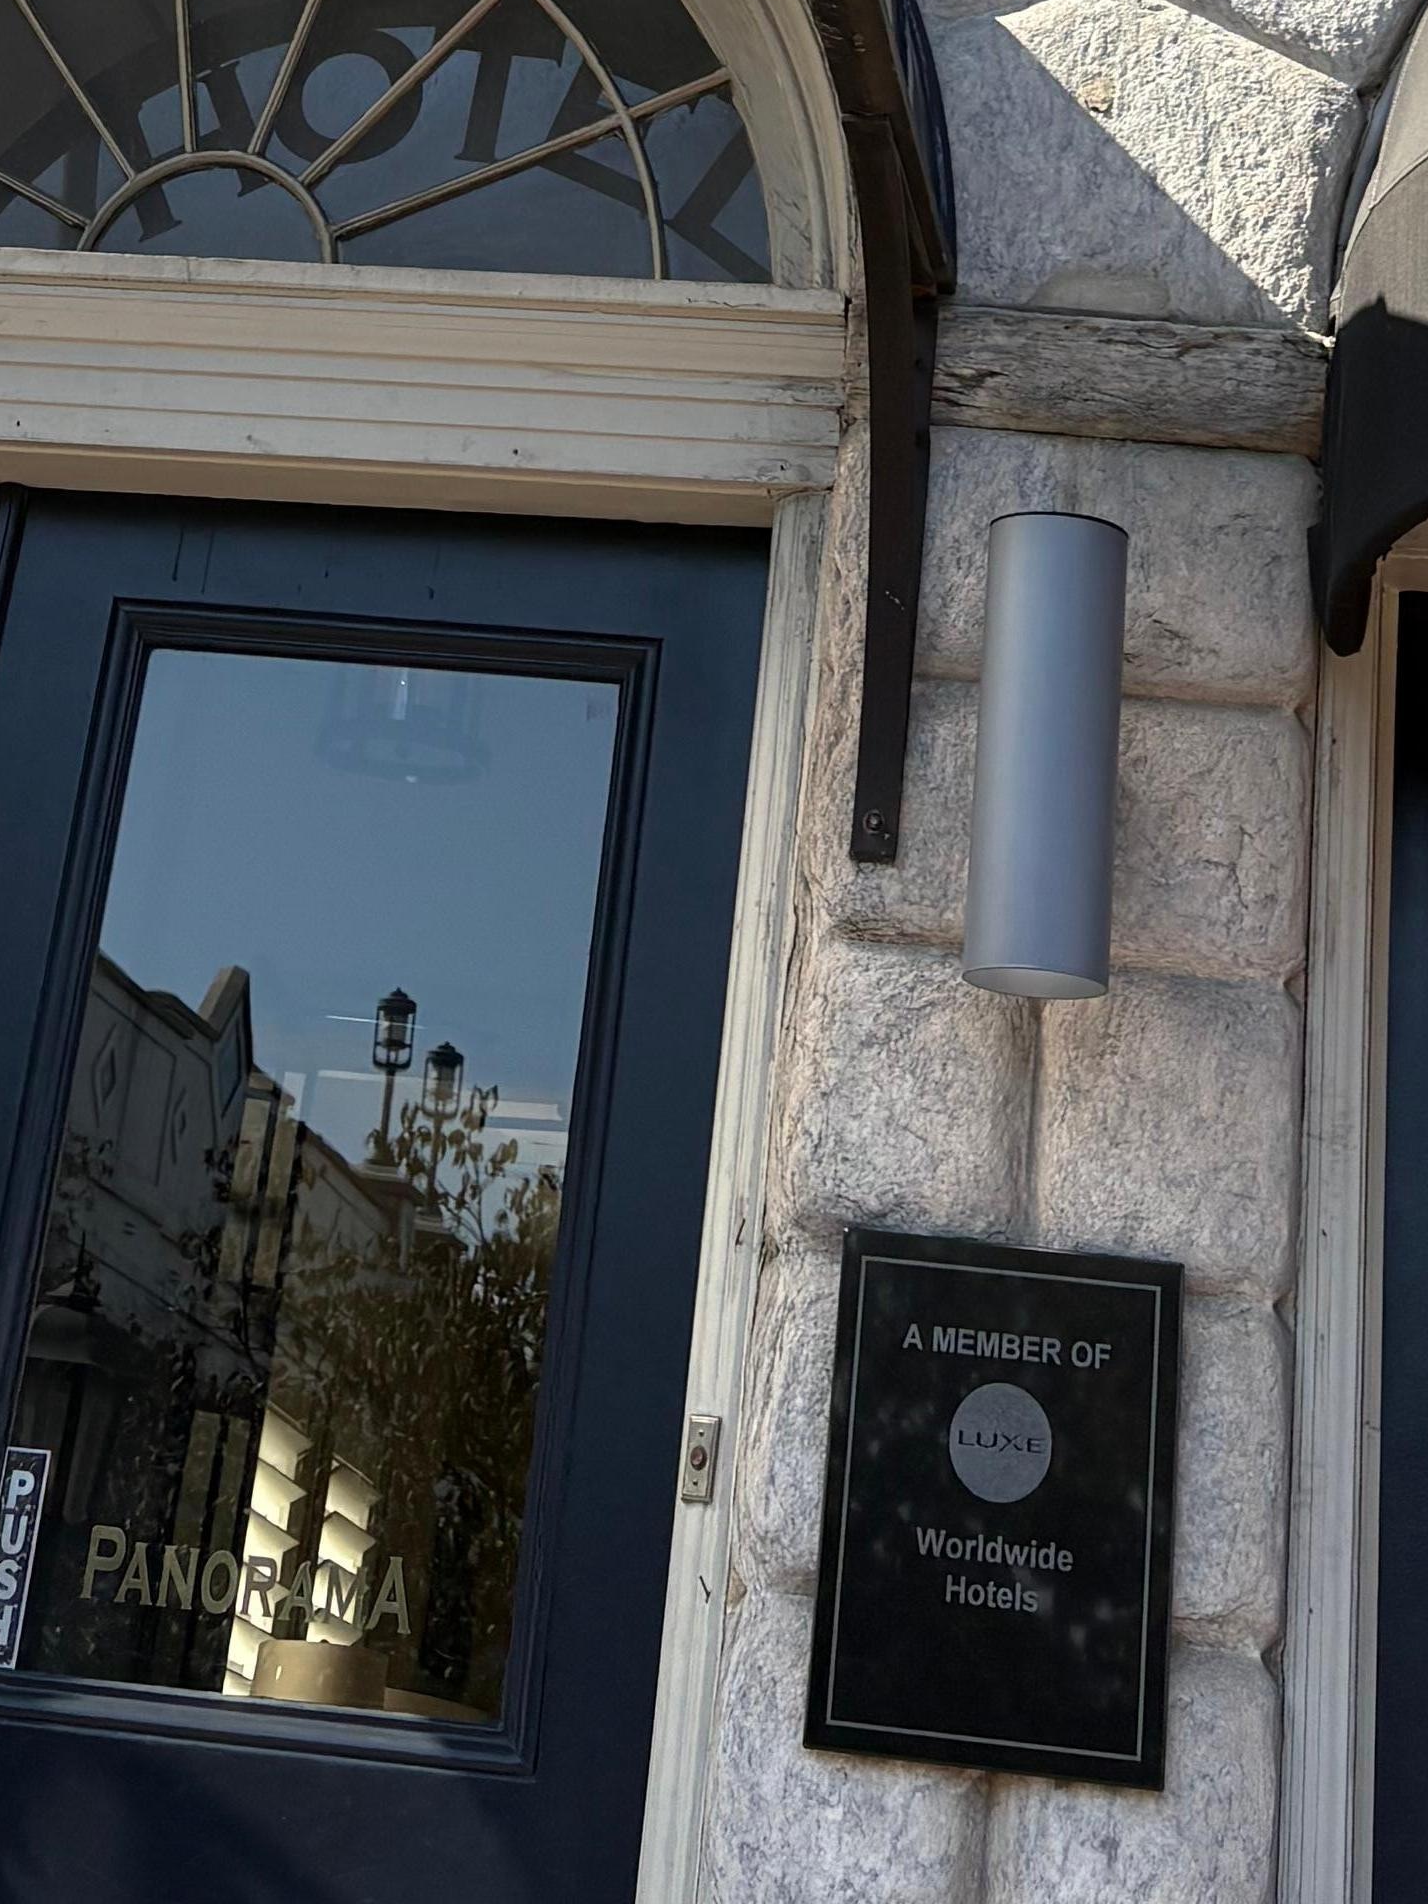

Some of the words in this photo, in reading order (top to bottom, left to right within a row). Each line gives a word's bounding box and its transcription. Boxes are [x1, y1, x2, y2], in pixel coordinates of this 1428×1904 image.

[902, 1324, 924, 1351] A
[932, 1326, 1062, 1366] MEMBER
[1071, 1340, 1112, 1370] OF
[958, 1429, 1047, 1455] LUXE
[916, 1526, 1074, 1573] Worldwide
[79, 1524, 412, 1635] PANORAMA
[945, 1575, 1039, 1613] Hotels
